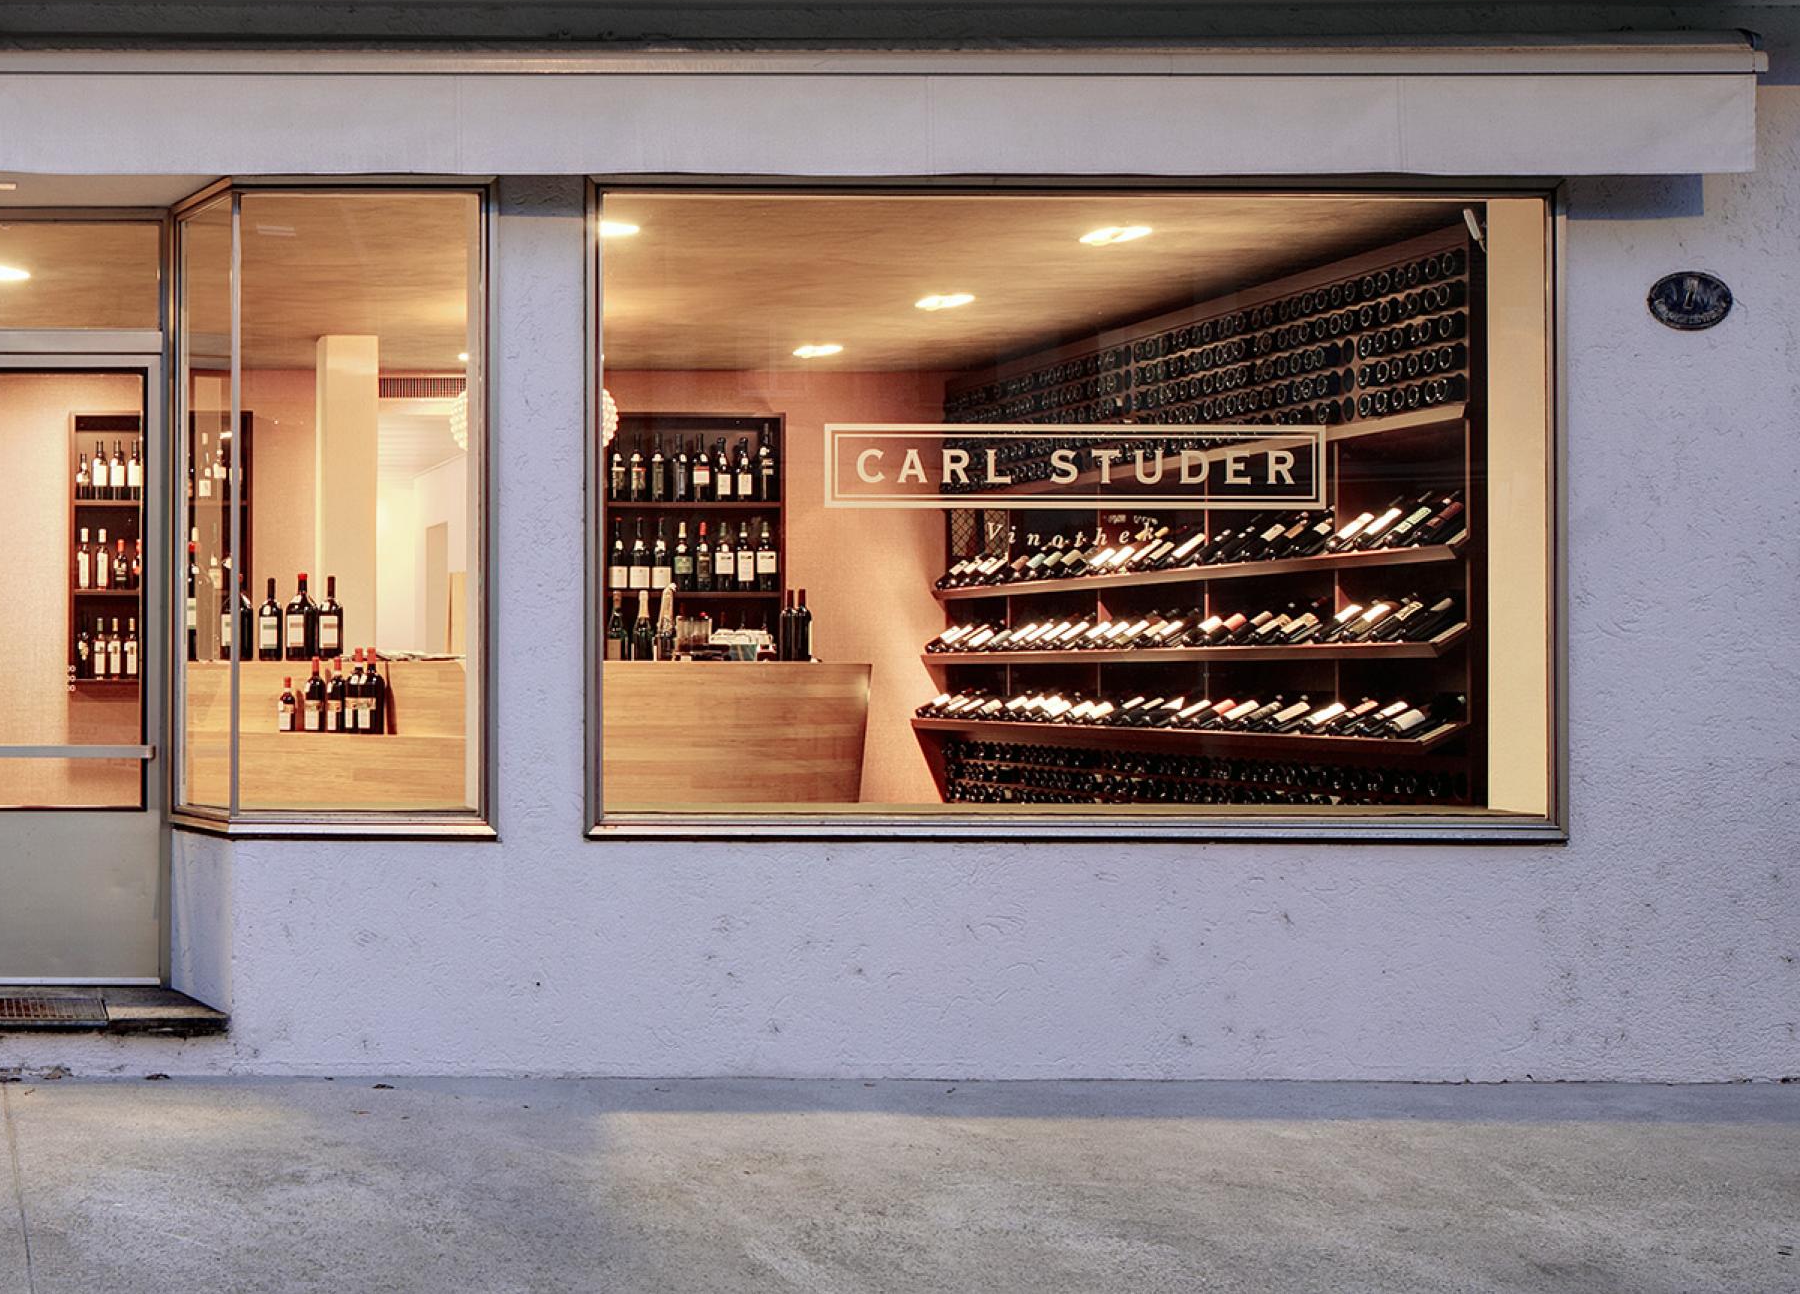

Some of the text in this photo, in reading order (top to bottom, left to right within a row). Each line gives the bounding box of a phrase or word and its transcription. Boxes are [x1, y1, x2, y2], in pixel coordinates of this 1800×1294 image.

[855, 448, 1296, 485] CARL STUDER
[986, 522, 1157, 549] Vinothek
